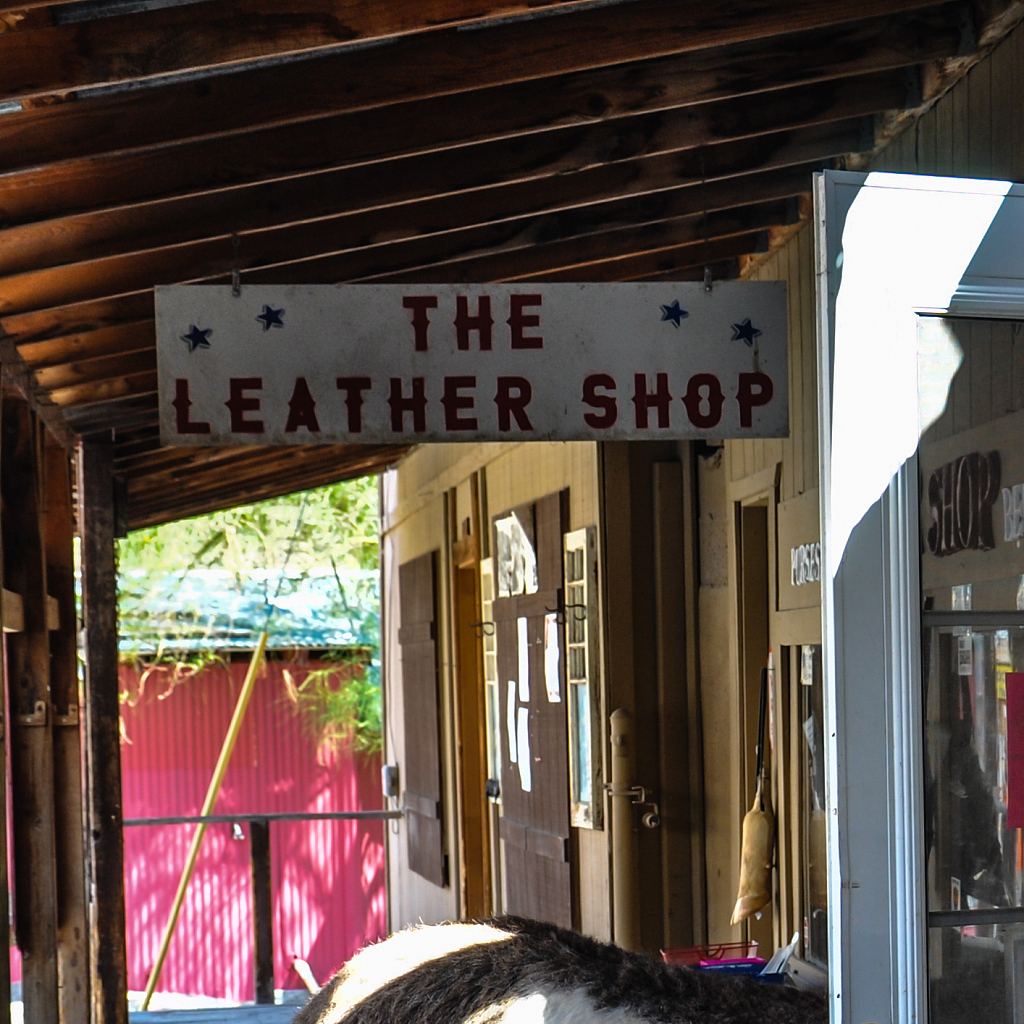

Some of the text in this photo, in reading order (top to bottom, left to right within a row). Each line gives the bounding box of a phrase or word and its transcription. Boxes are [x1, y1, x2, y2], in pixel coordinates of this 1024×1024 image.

[402, 294, 543, 351] THE
[172, 372, 774, 434] LEATHER SHOP
[927, 450, 1001, 557] SHOP
